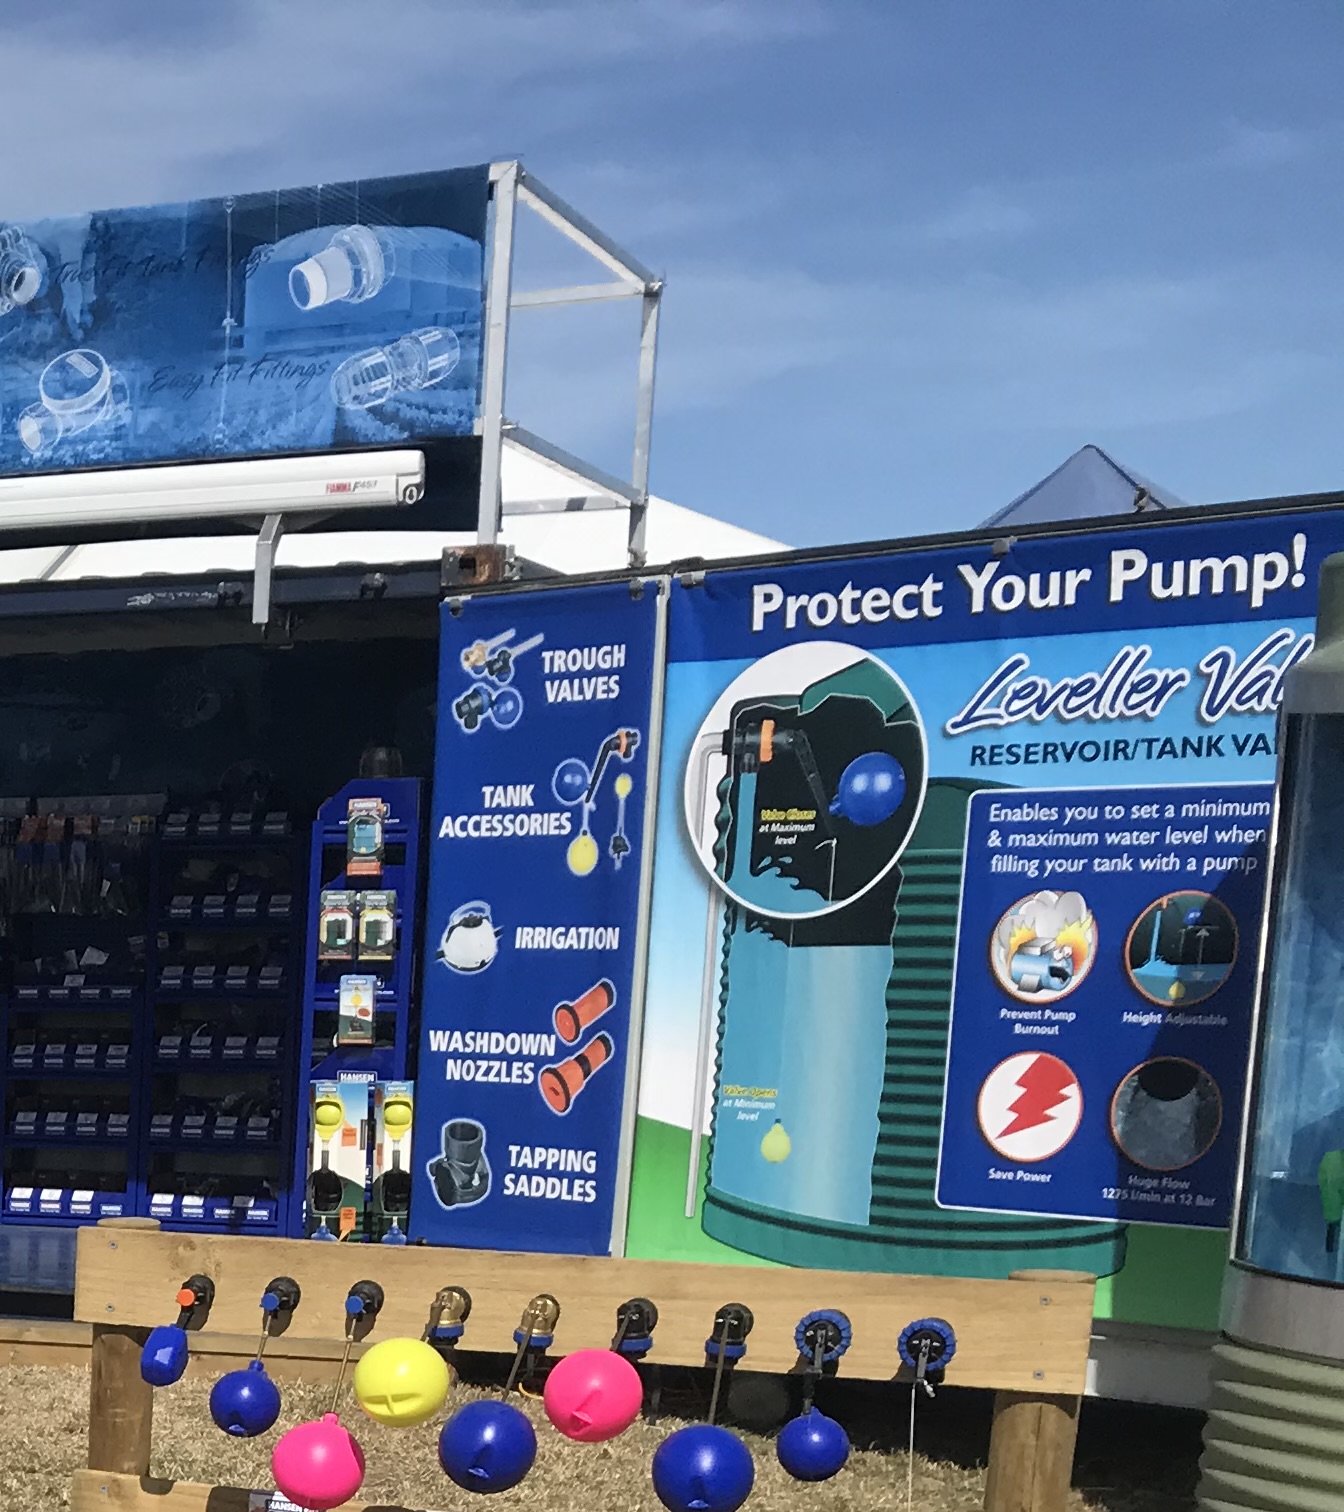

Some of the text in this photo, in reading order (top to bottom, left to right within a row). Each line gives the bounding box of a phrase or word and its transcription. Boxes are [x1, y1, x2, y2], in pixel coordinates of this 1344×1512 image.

[249, 357, 331, 389] Fittings
[751, 532, 1307, 632] Protect Your Pump!
[541, 644, 626, 673] TROUGH
[545, 675, 620, 703] VALVES
[945, 627, 1315, 735] Leveller Val
[970, 735, 1225, 766] RESERVOIR/TANK
[482, 784, 535, 808] TANK
[988, 799, 1270, 825] Enables you to set a minimum
[438, 812, 572, 838] ACCESSORIES
[770, 822, 816, 832] Maximum
[987, 825, 1266, 848] & maximum water level when
[775, 835, 798, 845] level
[990, 851, 1257, 878] filling your tank with a pump
[515, 926, 619, 950] IRRIGATION
[1000, 1008, 1076, 1022] Prevent Pump
[1122, 1011, 1228, 1027] Height Adjustable
[1014, 1024, 1059, 1035] Burnout
[429, 1029, 556, 1056] WASHDOWN
[340, 1072, 375, 1082] HANSEN
[445, 1058, 535, 1084] NOZZLES
[734, 1099, 775, 1109] Minimum
[737, 1111, 759, 1120] level
[509, 1145, 597, 1173] TAPPING
[989, 1168, 1052, 1183] Save Power
[1162, 1176, 1190, 1189] Flow
[503, 1174, 596, 1203] SADDLES
[1102, 1188, 1128, 1200] 1275
[268, 1501, 303, 1512] HANSEN
